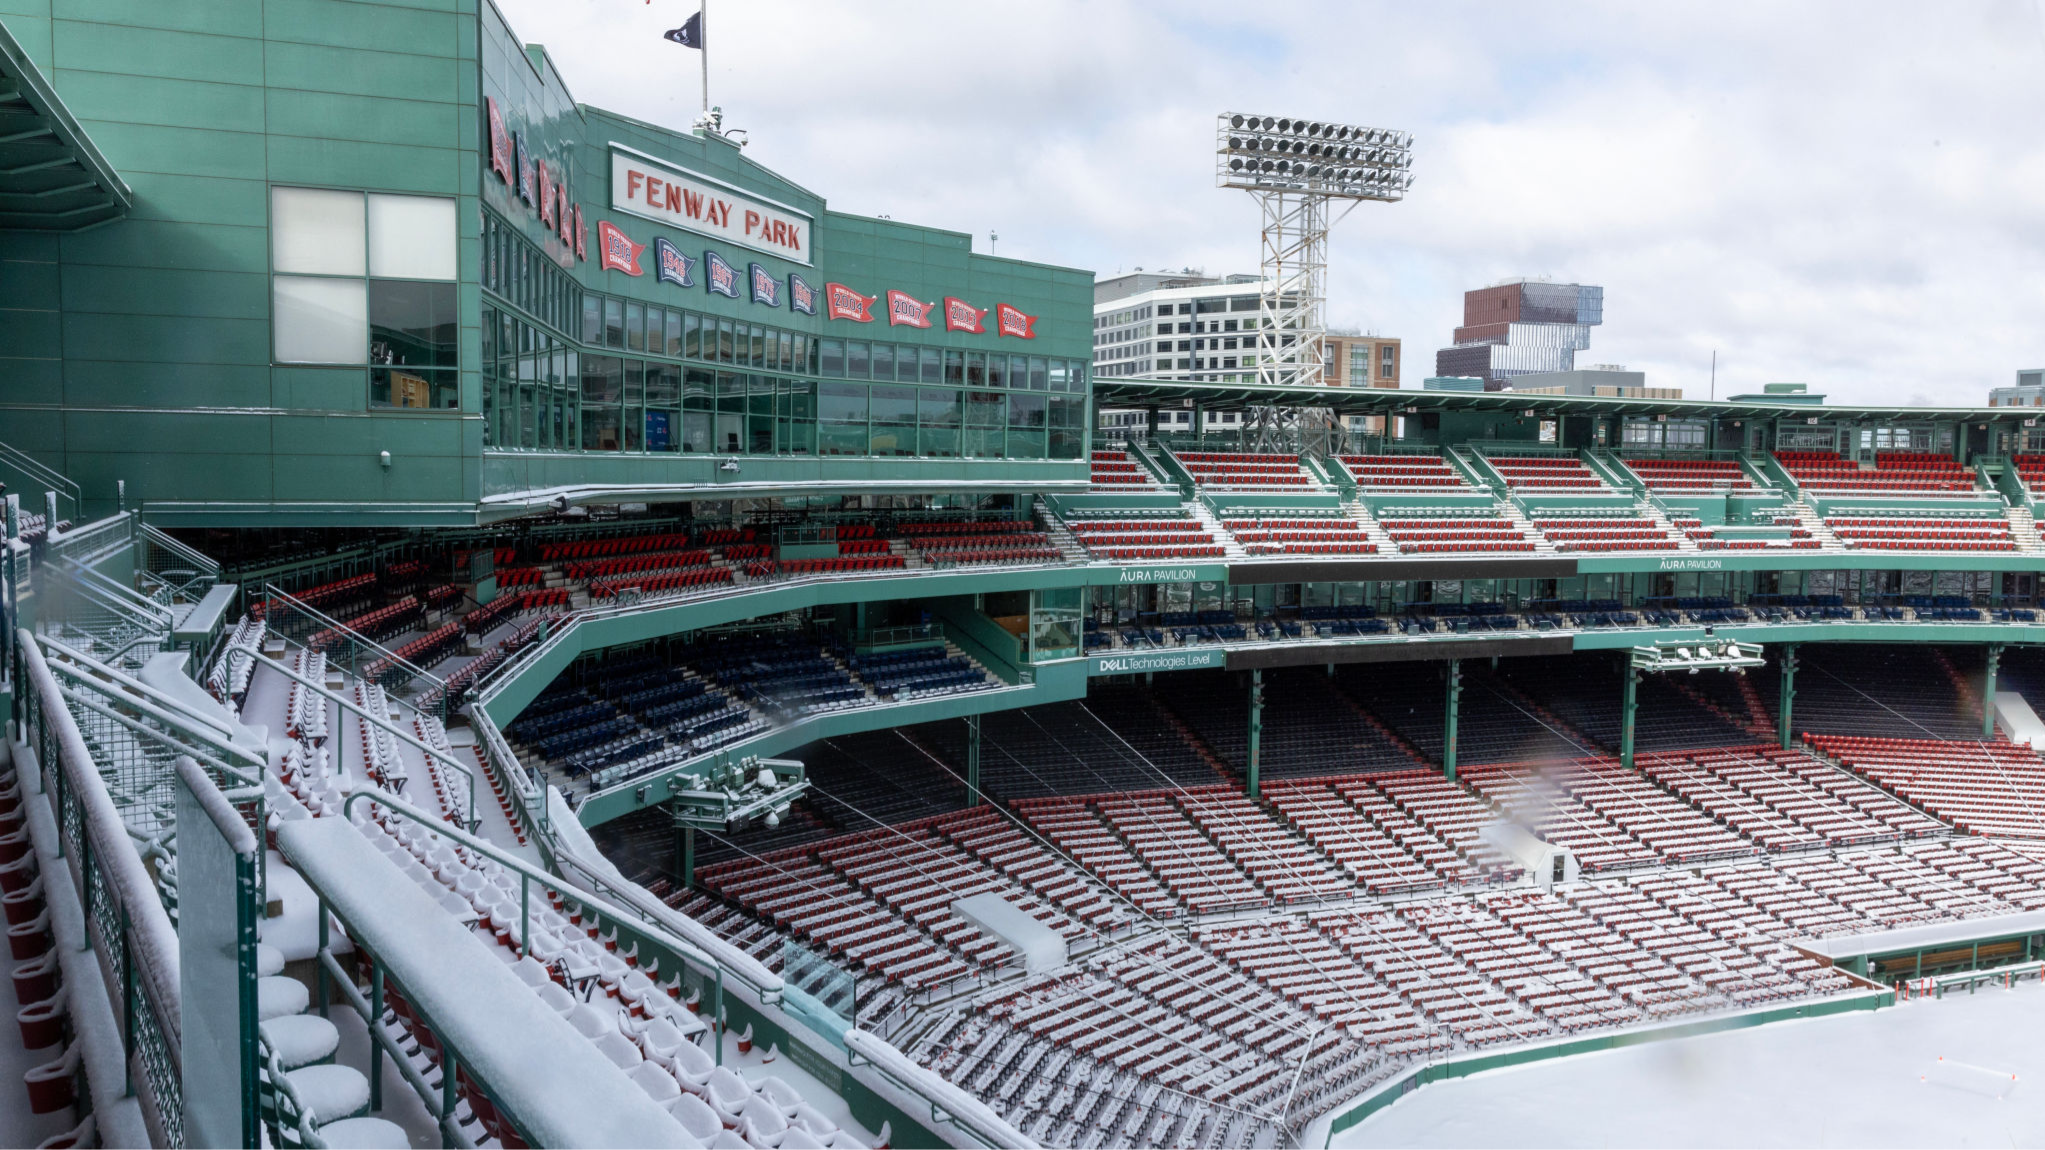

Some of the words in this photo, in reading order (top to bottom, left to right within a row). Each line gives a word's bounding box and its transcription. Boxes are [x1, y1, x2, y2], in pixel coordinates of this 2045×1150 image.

[627, 169, 733, 228] FENWAY
[745, 209, 801, 251] PARK
[608, 235, 632, 263] 1918
[663, 249, 686, 278] 1946
[712, 262, 733, 289] 1967
[834, 293, 863, 314] 2004
[894, 300, 922, 320] 2007
[951, 306, 977, 326] 2013
[1003, 311, 1027, 332] 2018
[1153, 569, 1196, 580] PAVILION
[1687, 560, 1722, 569] PAVILION
[1100, 659, 1128, 672] DELL
[1128, 656, 1185, 669] Technologies
[1187, 653, 1210, 666] Level
